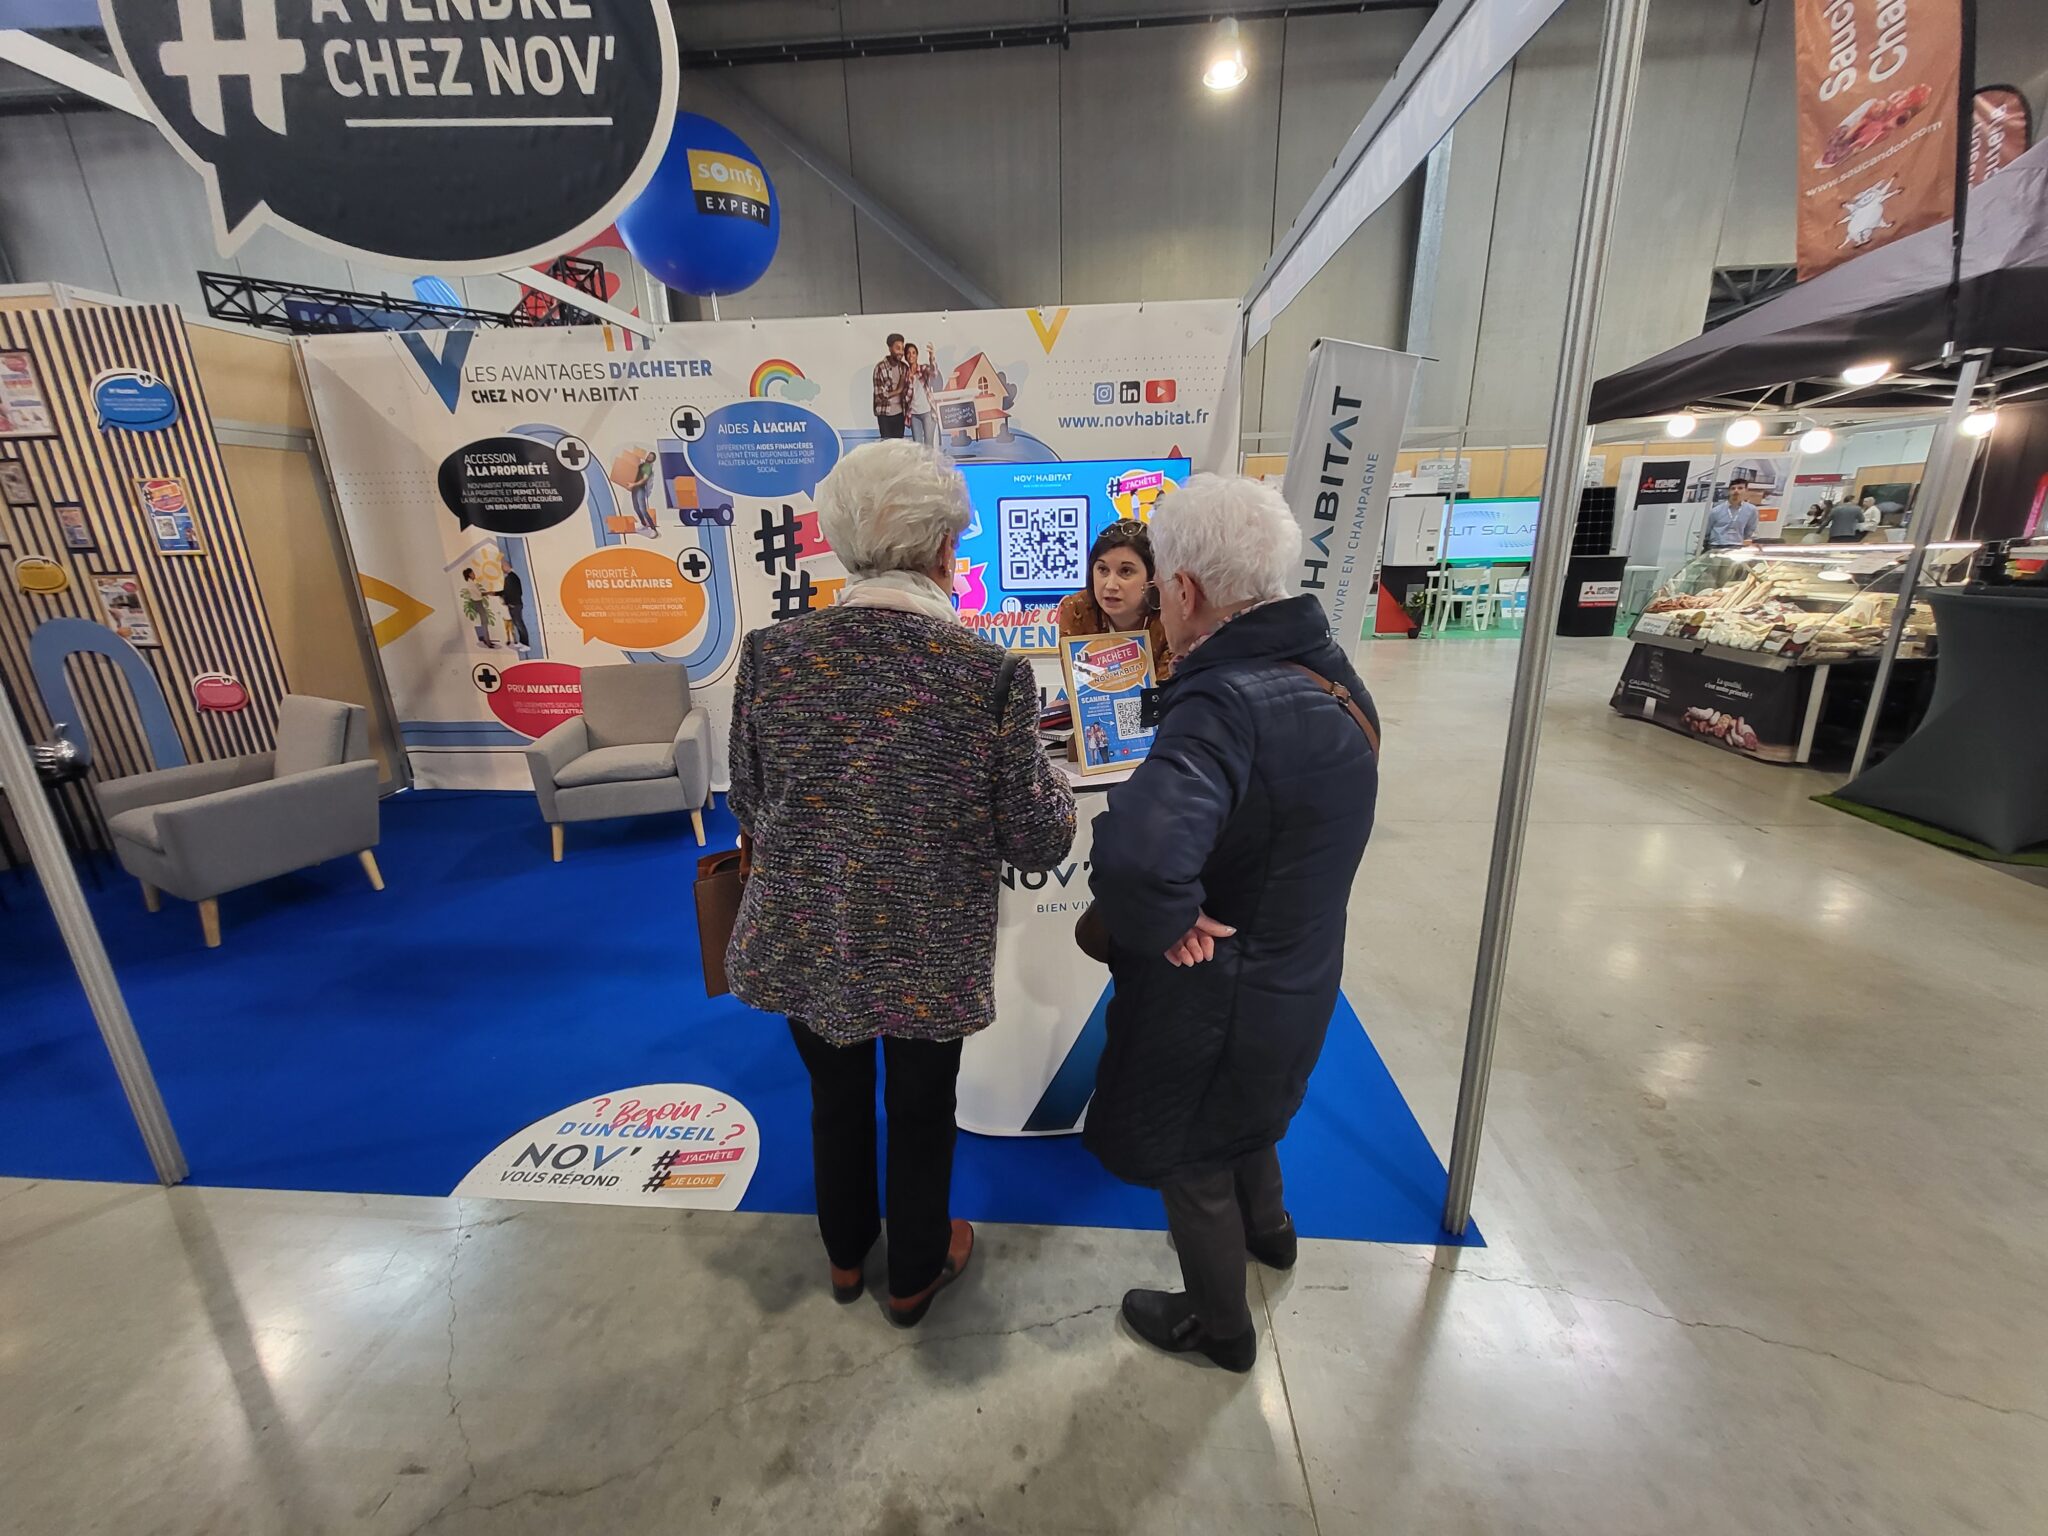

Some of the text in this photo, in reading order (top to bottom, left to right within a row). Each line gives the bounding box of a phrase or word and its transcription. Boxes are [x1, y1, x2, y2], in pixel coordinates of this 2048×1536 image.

[1868, 0, 1907, 83] Cha
[323, 35, 615, 97] CHEZ NOV'
[697, 161, 762, 192] somfy
[706, 196, 765, 220] EXPERT
[465, 359, 713, 383] LES AVANTAGES D'ACHETER
[471, 389, 507, 404] CHEZ
[563, 386, 640, 402] HABITAT
[1058, 408, 1209, 428] www.novhabitat.fr
[718, 420, 807, 434] AIDES À L'ACHAT
[756, 442, 774, 450] AIDES
[775, 441, 813, 450] FINANCIÈRES
[464, 453, 516, 465] ACCESSION
[466, 462, 549, 477] À LA PROPRIÉTÉ
[1035, 473, 1072, 482] HABITAT
[1300, 386, 1362, 589] HABITAT
[494, 503, 508, 511] BIEN
[508, 503, 541, 511] IMMOBILIER
[1332, 579, 1349, 622] VIVRE
[1341, 555, 1355, 575] EN
[1349, 452, 1379, 549] CHAMPAGNE
[585, 566, 638, 579] PRIORITÉ À
[587, 578, 673, 589] NOS LOCATAIRES
[507, 684, 582, 694] PRIX AVANTAGE
[1081, 695, 1110, 704] SCANNEZ
[1037, 903, 1067, 913] BIEN
[612, 1099, 703, 1130] Besoin
[556, 1121, 617, 1139] D'UN
[618, 1123, 716, 1142] CONSEIL
[512, 1142, 643, 1171] NOV'
[500, 1170, 621, 1187] VOUS RÉPOND
[687, 1176, 716, 1186] LOUE
